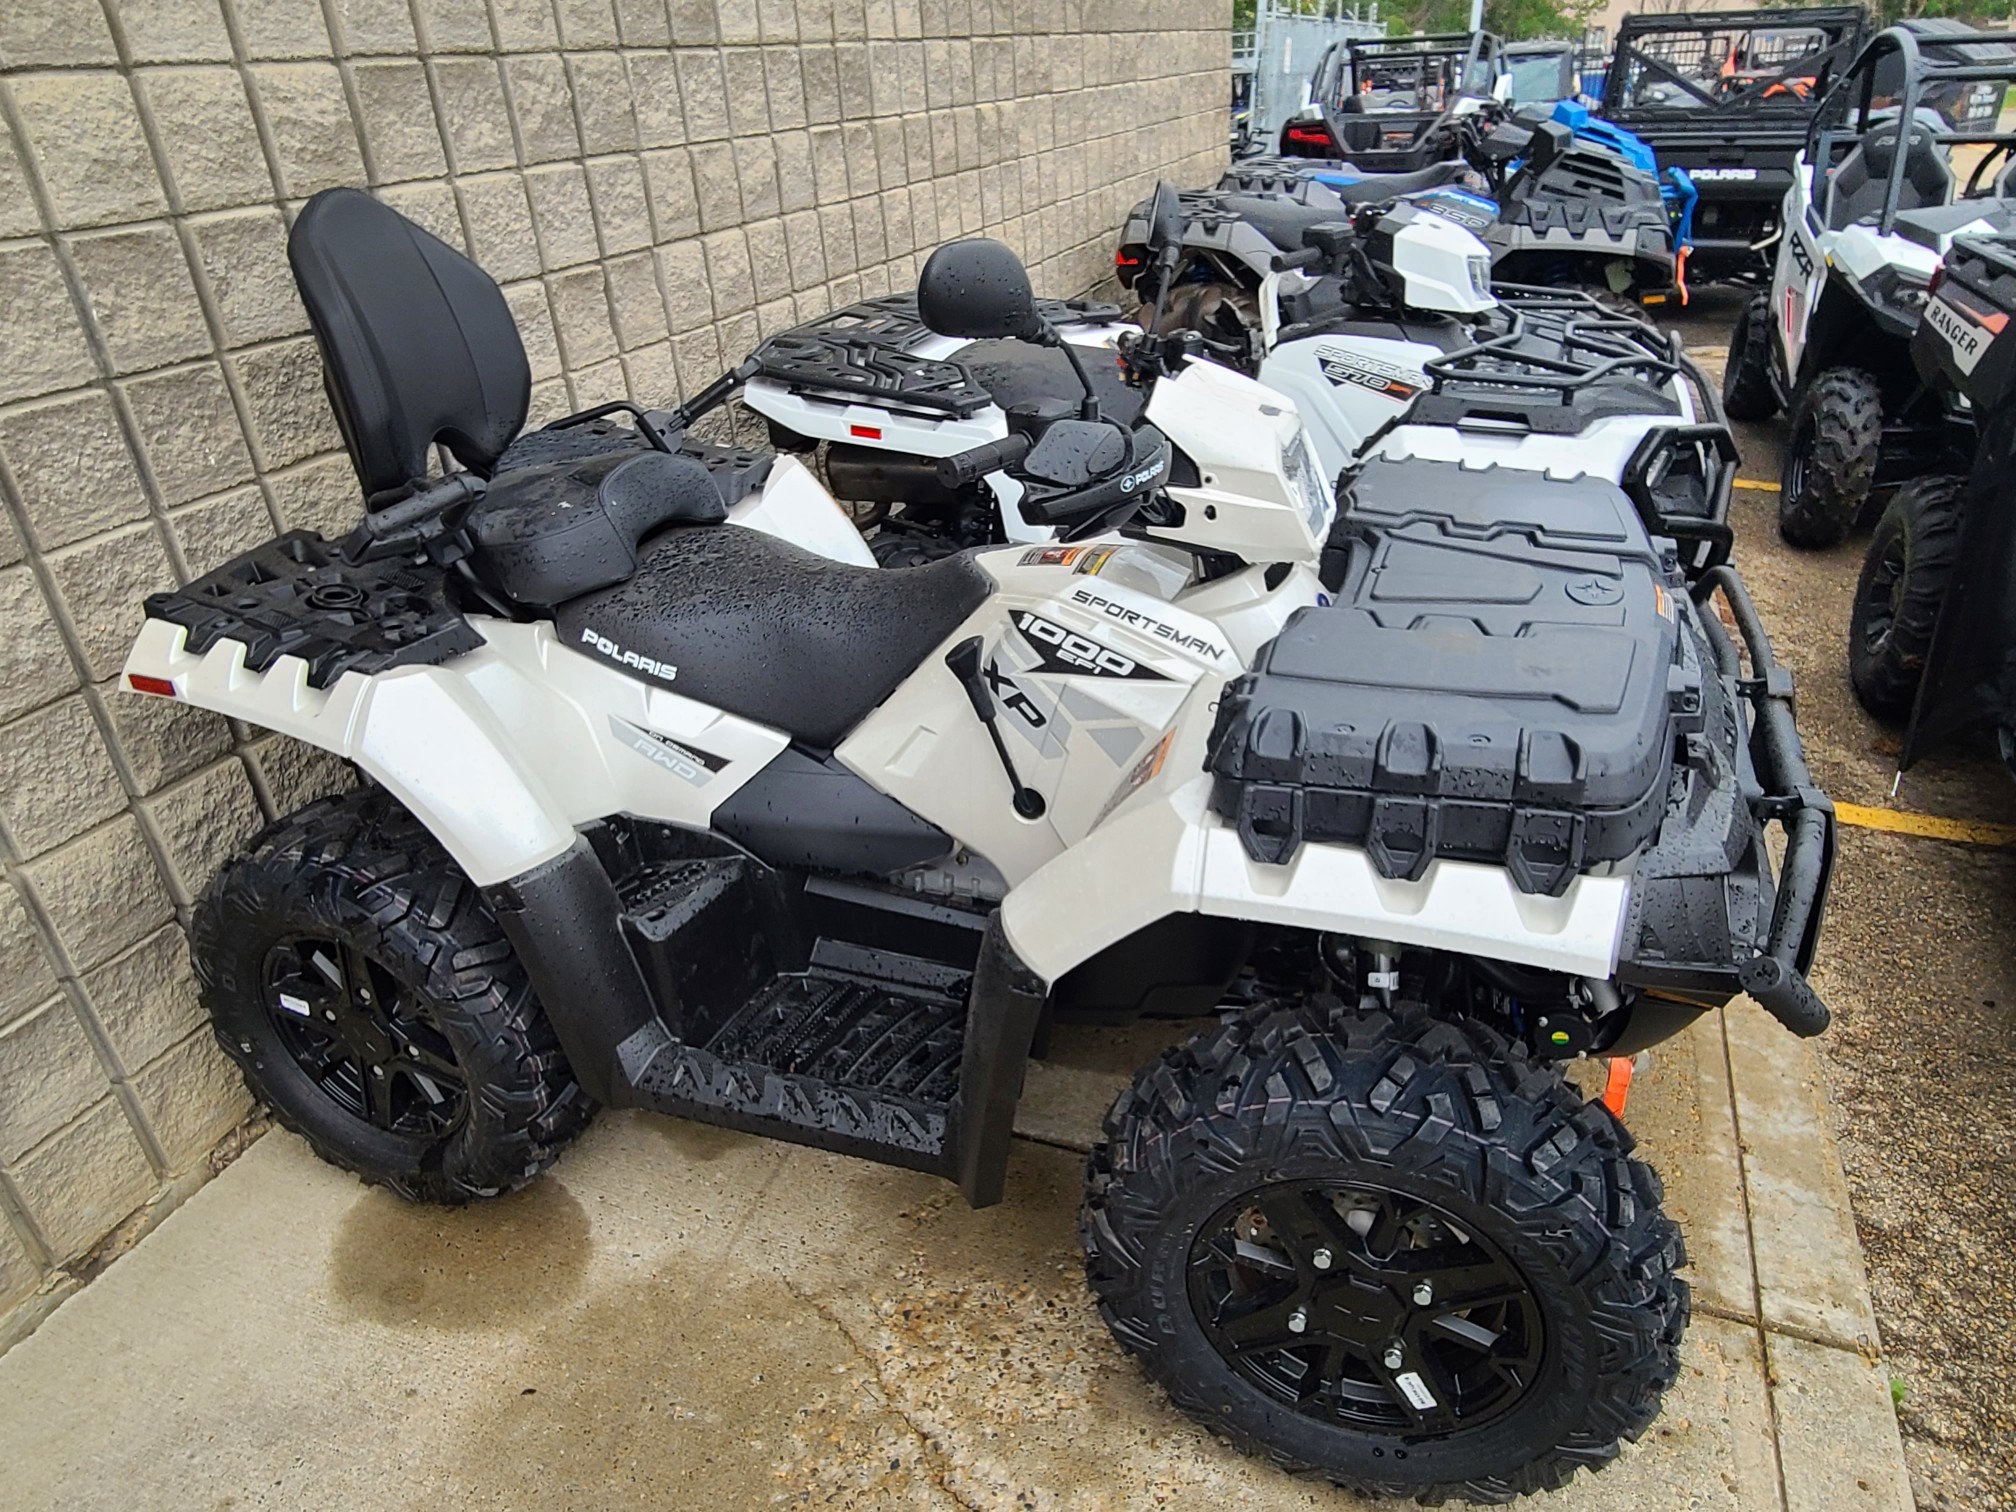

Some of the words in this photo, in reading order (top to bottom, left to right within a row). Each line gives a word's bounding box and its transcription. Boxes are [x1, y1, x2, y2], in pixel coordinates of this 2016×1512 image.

[1689, 168, 1757, 181] POLARIS
[1789, 229, 1814, 286] RZR
[1930, 305, 1978, 356] RANGER
[1313, 344, 1434, 390] SPORTSMAN
[1324, 362, 1392, 391] 570
[1135, 460, 1165, 486] POLARIS
[1018, 612, 1136, 677] 1000
[1071, 589, 1225, 661] SPORTSMAN
[580, 627, 678, 681] POLARIS
[1055, 649, 1101, 675] EFI
[982, 655, 1048, 729] XP
[633, 738, 697, 780] AWD
